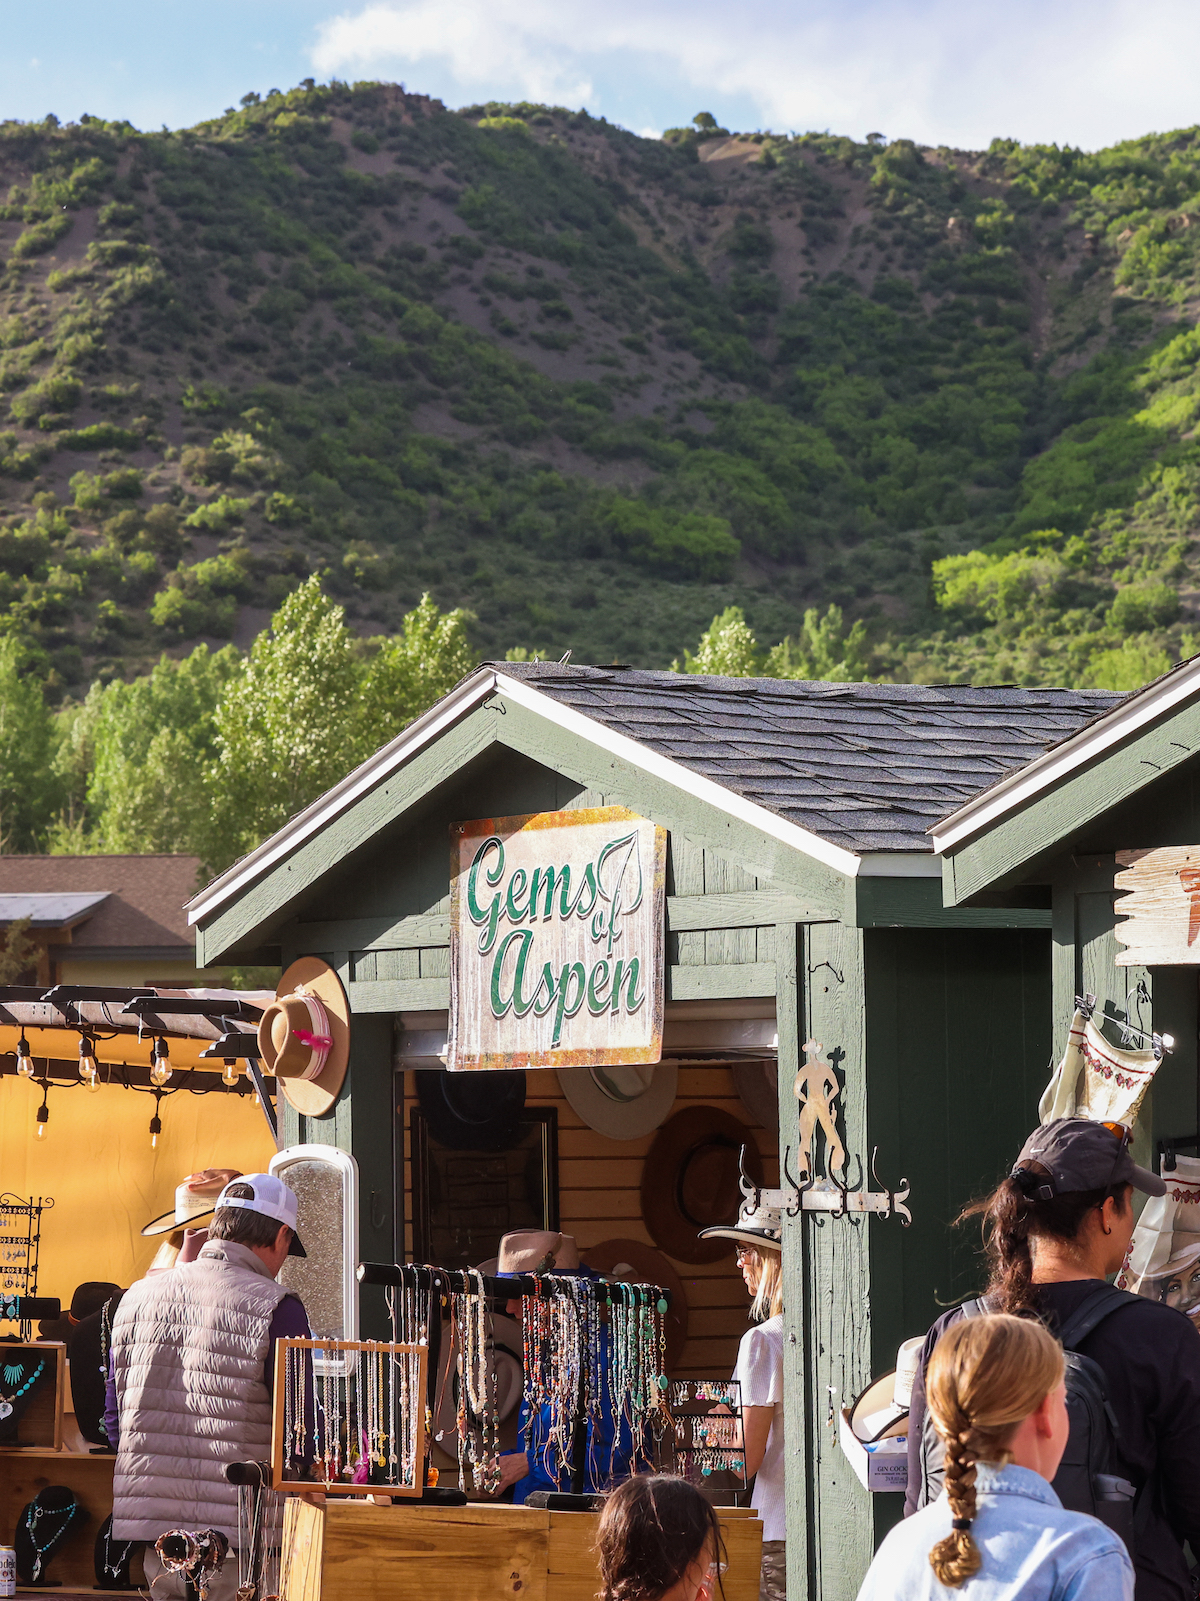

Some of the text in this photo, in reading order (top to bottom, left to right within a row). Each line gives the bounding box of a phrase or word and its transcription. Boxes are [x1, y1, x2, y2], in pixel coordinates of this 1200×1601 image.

[467, 836, 599, 956] Gems
[591, 888, 623, 959] of
[490, 928, 646, 1050] Aspen
